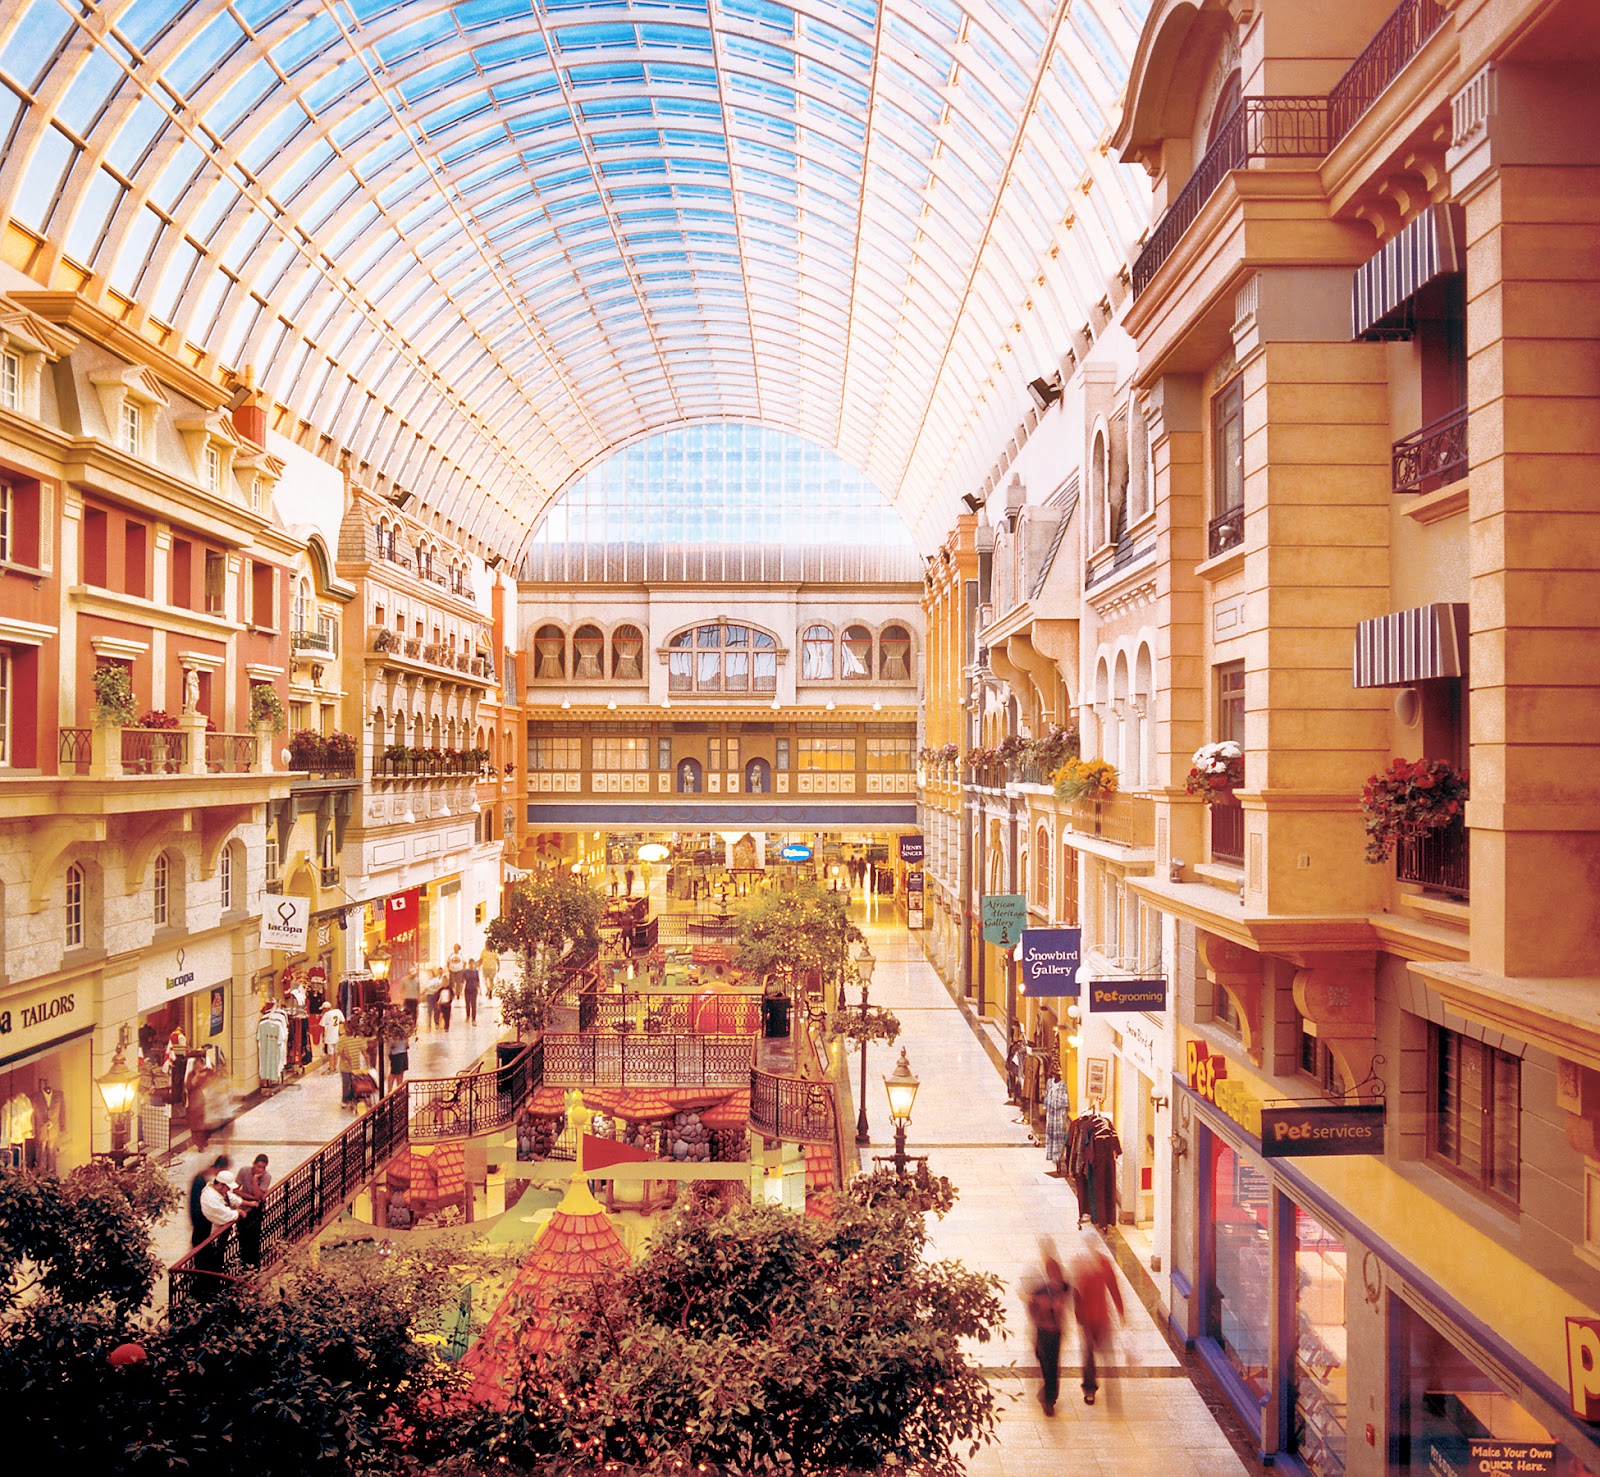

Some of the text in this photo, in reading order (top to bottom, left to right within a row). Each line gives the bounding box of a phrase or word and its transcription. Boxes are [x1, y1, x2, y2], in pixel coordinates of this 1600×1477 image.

[984, 900, 1016, 909] African
[991, 909, 1026, 919] Heritage
[268, 923, 303, 934] lacopa
[984, 918, 1014, 928] Gallery
[1025, 947, 1078, 962] Snowbird
[1031, 962, 1072, 979] Gallery
[166, 972, 194, 990] lacopa
[21, 993, 75, 1029] TAILORS
[1274, 1121, 1372, 1140] Pet services
[1472, 1446, 1553, 1459] Make Your Own
[1479, 1459, 1547, 1473] QUICK Here.
